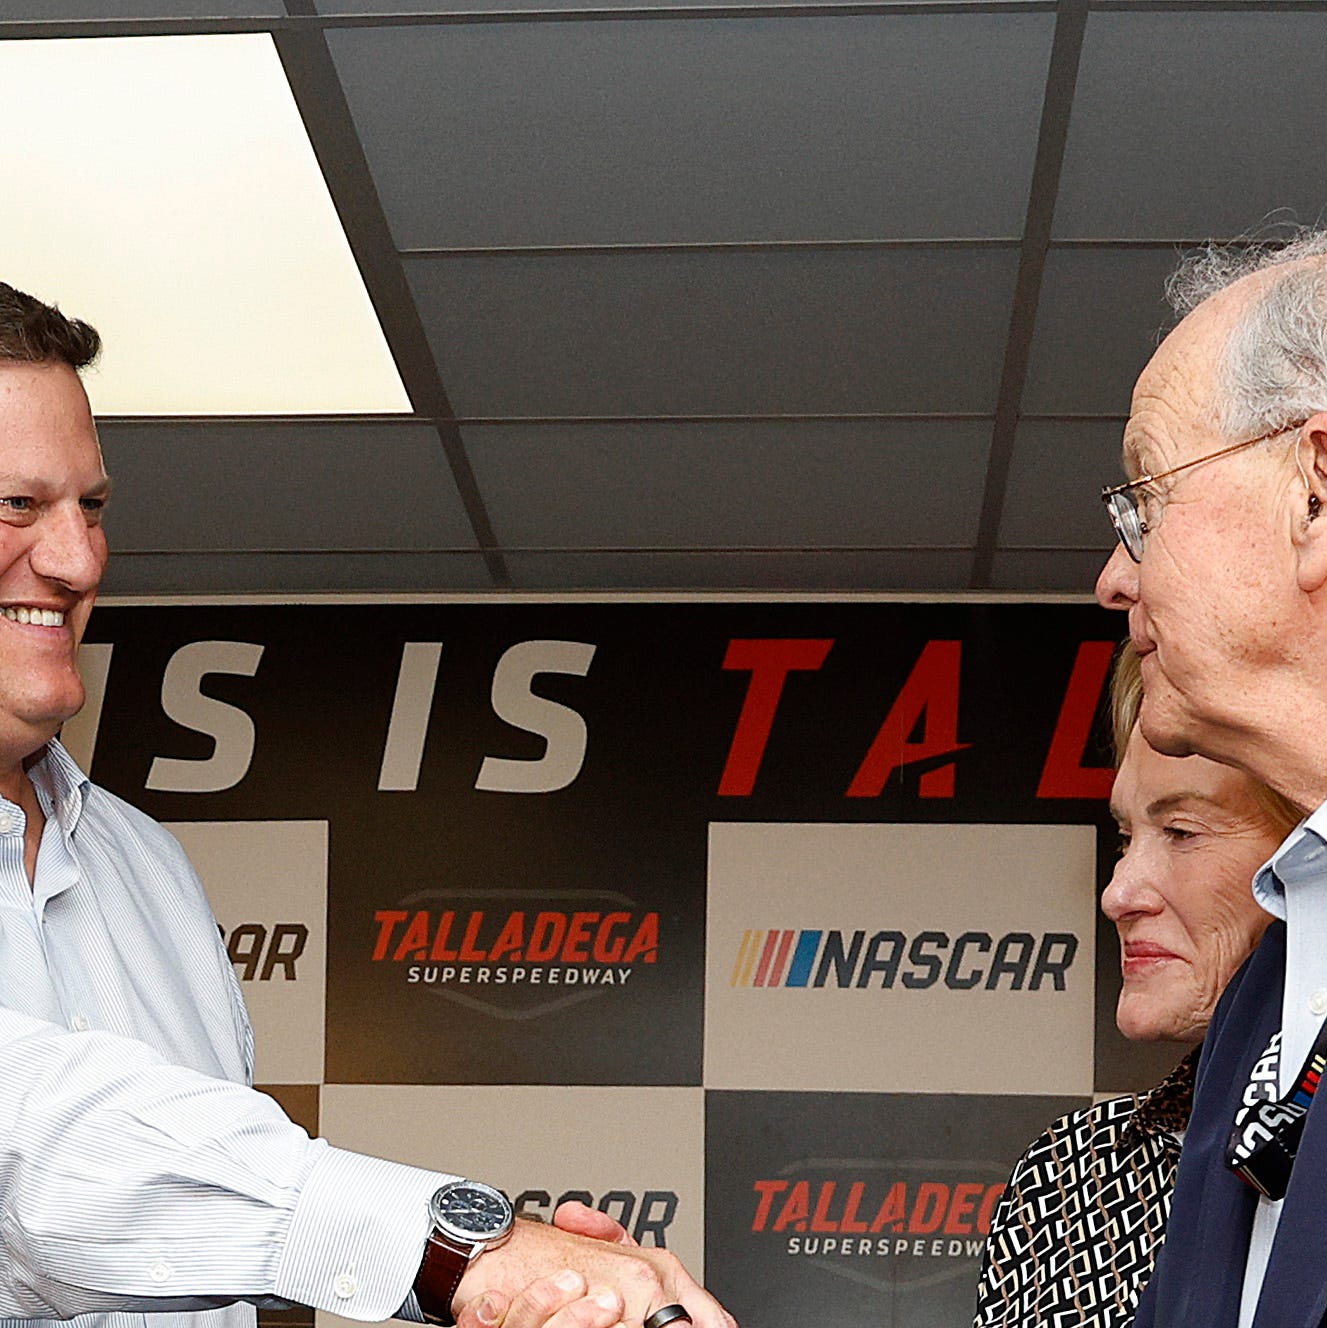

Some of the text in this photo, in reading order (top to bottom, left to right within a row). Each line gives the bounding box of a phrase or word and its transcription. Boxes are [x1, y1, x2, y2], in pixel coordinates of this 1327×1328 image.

[377, 640, 598, 793] IS
[372, 910, 660, 963] TALLADEGA
[812, 930, 1080, 992] NASCAR
[407, 966, 632, 985] SUPERSPEEDWAY
